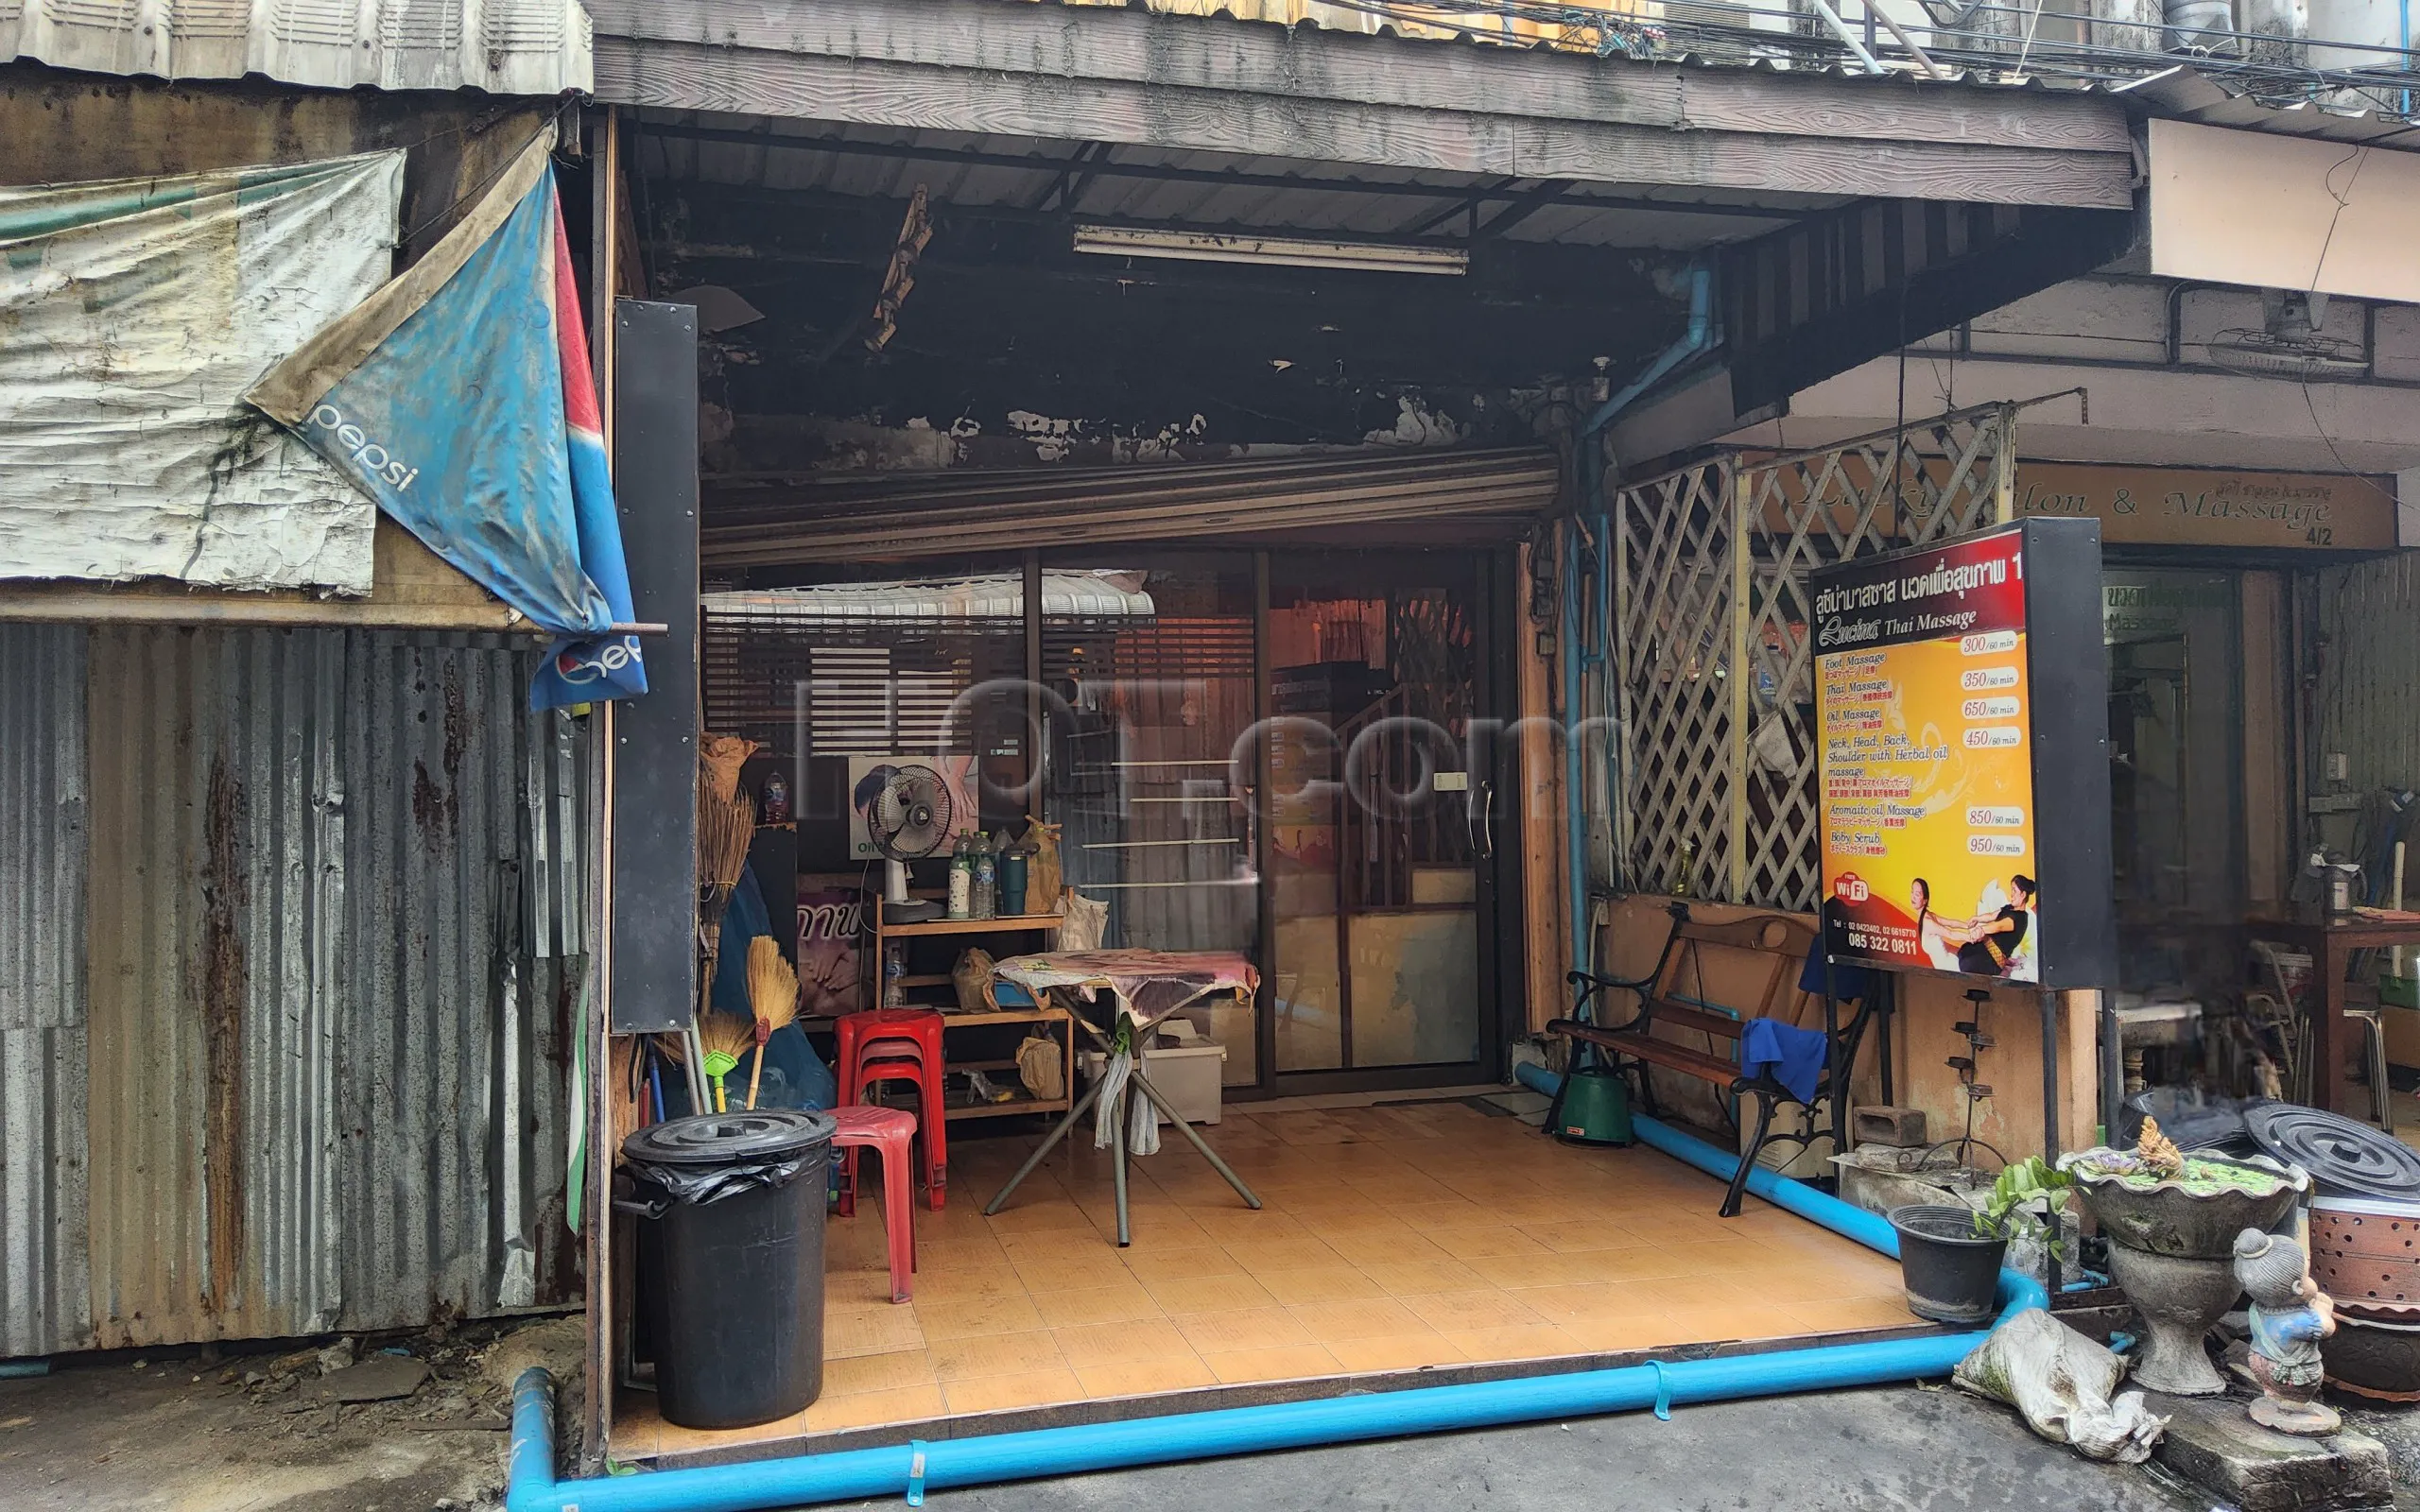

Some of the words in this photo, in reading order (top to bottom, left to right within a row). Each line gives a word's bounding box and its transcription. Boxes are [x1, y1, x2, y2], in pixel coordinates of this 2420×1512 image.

[306, 404, 419, 492] pepsi
[2114, 487, 2138, 515] &
[2162, 487, 2332, 530] Massage
[2306, 525, 2333, 546] 4/2
[1901, 558, 2006, 600] นวดเพื่อสุขภาพ
[2012, 552, 2022, 579] 1
[1819, 615, 1882, 646] Lucina
[1885, 616, 1913, 637] Thai
[1916, 610, 1977, 633] Massage
[1963, 635, 1998, 653] 300/60
[1999, 638, 2014, 648] min
[1824, 658, 1842, 670] Foot
[1846, 653, 1886, 667] Massage
[1826, 684, 1844, 696] Thai
[1848, 680, 1888, 694] Massage
[1963, 672, 1998, 688] 350/60
[1999, 675, 2014, 685] min
[1826, 711, 1839, 722] Oil
[1841, 709, 1880, 721] Massage
[1964, 701, 1998, 718] 650/60
[1999, 704, 2014, 714] min
[1828, 739, 1850, 749] Neck,
[1853, 736, 1879, 747] Head,
[1883, 734, 1910, 747] Back,
[1965, 731, 2000, 747] 450/60
[2001, 734, 2016, 745] min
[1828, 751, 1866, 763] Shoulder
[1870, 749, 1892, 761] with
[1895, 747, 1929, 760] Herbal
[1933, 747, 1947, 759] oil
[1828, 768, 1864, 778] massage
[1871, 803, 1883, 816] oil
[1887, 804, 1926, 817] Massage
[1969, 809, 2003, 825] 850/60
[2005, 816, 2020, 825] min
[1854, 832, 1880, 843] Scrub
[1970, 838, 2004, 853] 950/60
[2005, 843, 2020, 853] min
[857, 841, 874, 853] Oil
[1833, 919, 1841, 928] Tel
[1882, 926, 1890, 935] 02
[1891, 926, 1916, 938] 6615770
[1848, 933, 1867, 949] 085
[1870, 936, 1889, 952] 322
[1892, 939, 1917, 955] 0811
